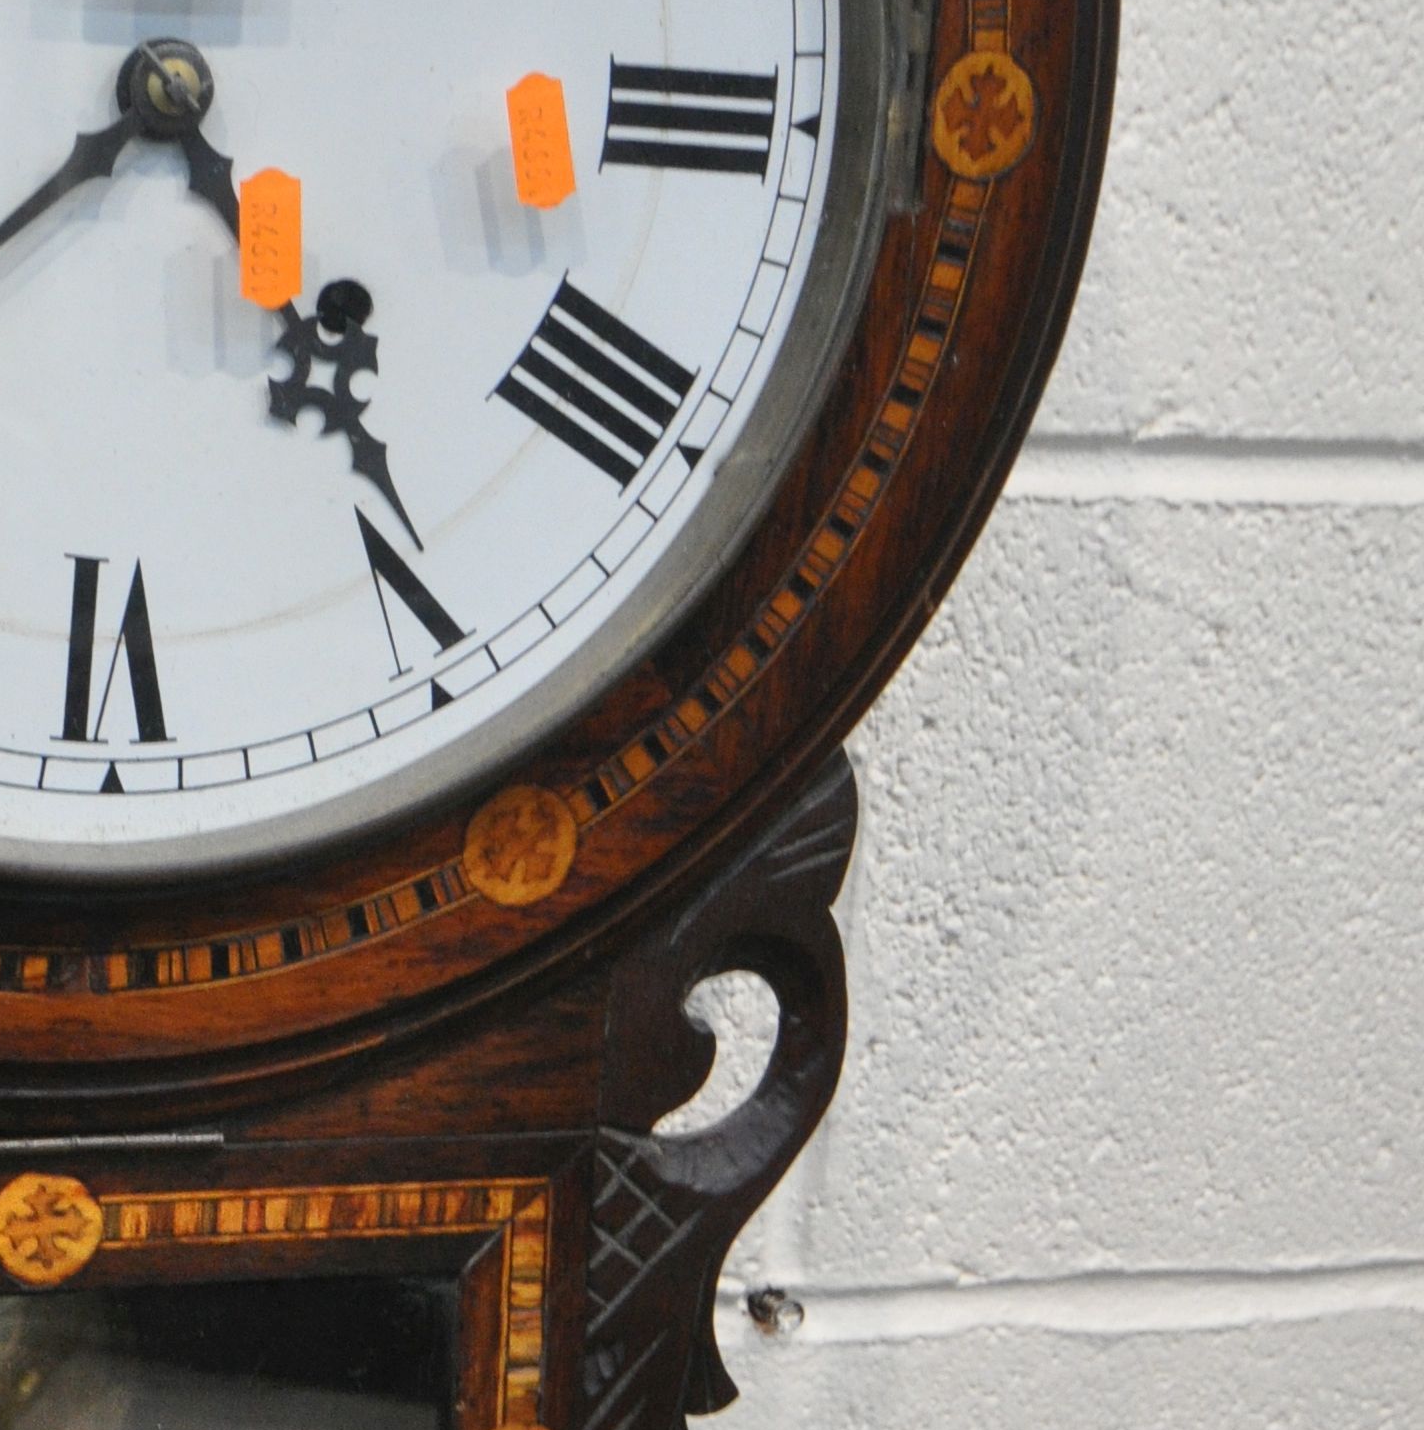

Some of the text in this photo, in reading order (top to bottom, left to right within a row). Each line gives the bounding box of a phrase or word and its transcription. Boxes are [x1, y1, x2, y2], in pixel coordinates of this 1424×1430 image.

[598, 53, 778, 186] III
[485, 267, 701, 497] IIII
[49, 552, 177, 743] VI
[354, 503, 476, 682] V
